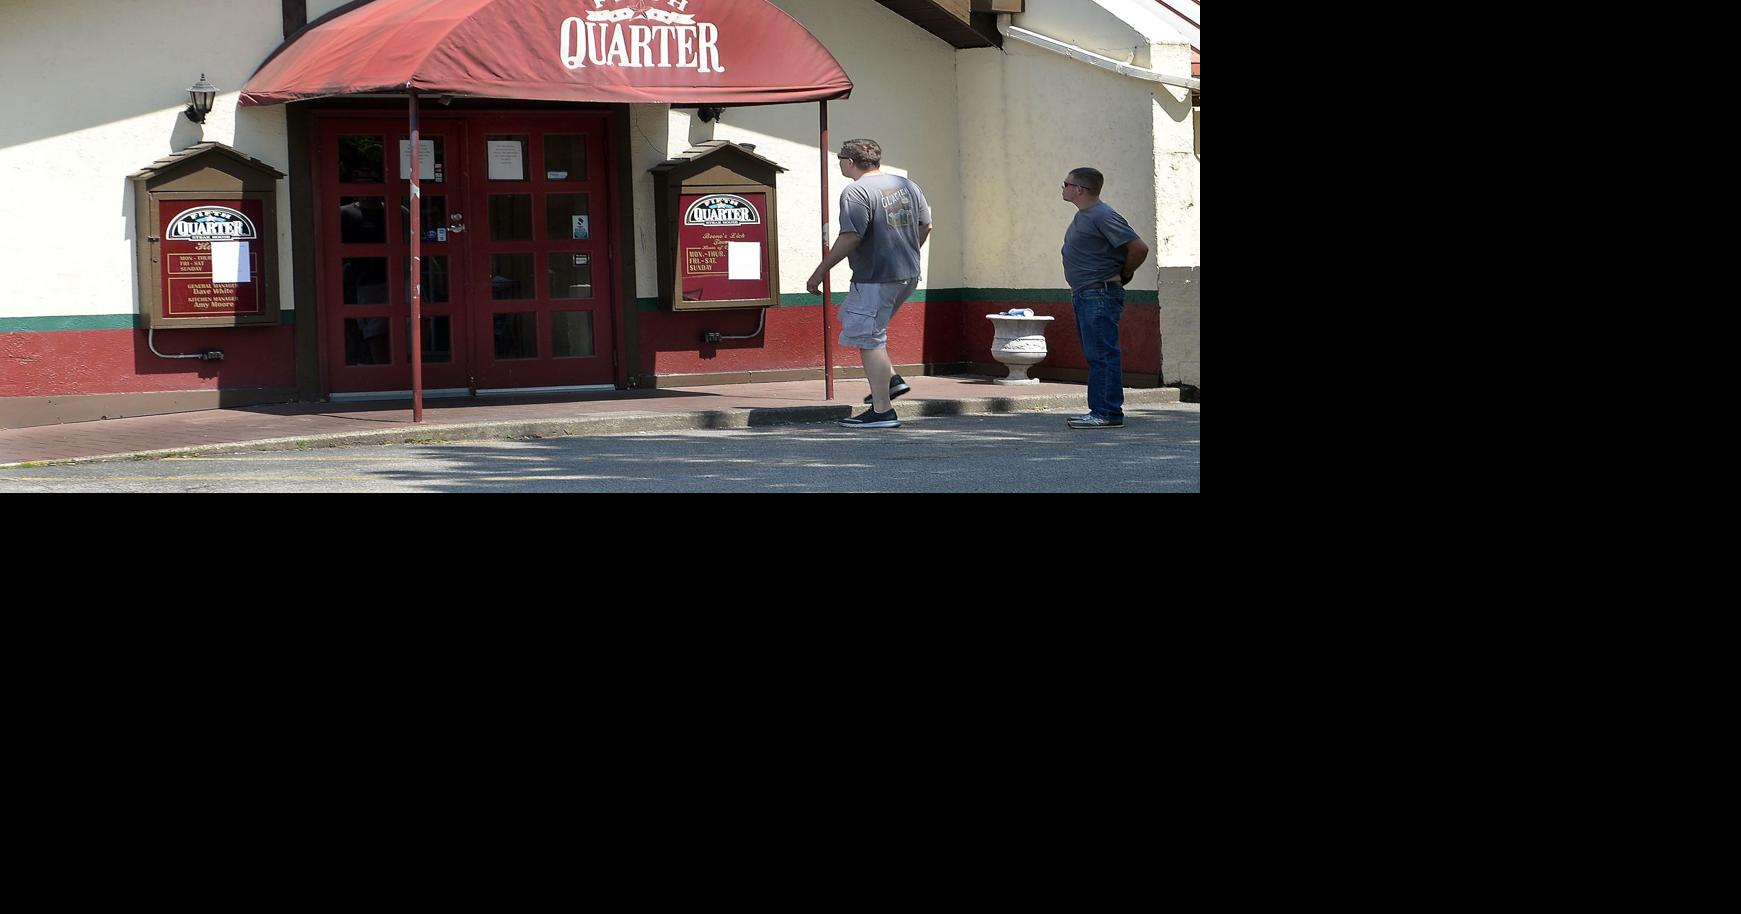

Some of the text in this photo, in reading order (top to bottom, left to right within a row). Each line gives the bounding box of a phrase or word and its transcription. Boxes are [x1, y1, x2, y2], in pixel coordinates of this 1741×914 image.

[560, 16, 726, 73] QUARTER
[694, 207, 750, 221] QUARTER
[178, 221, 243, 236] QUARTER
